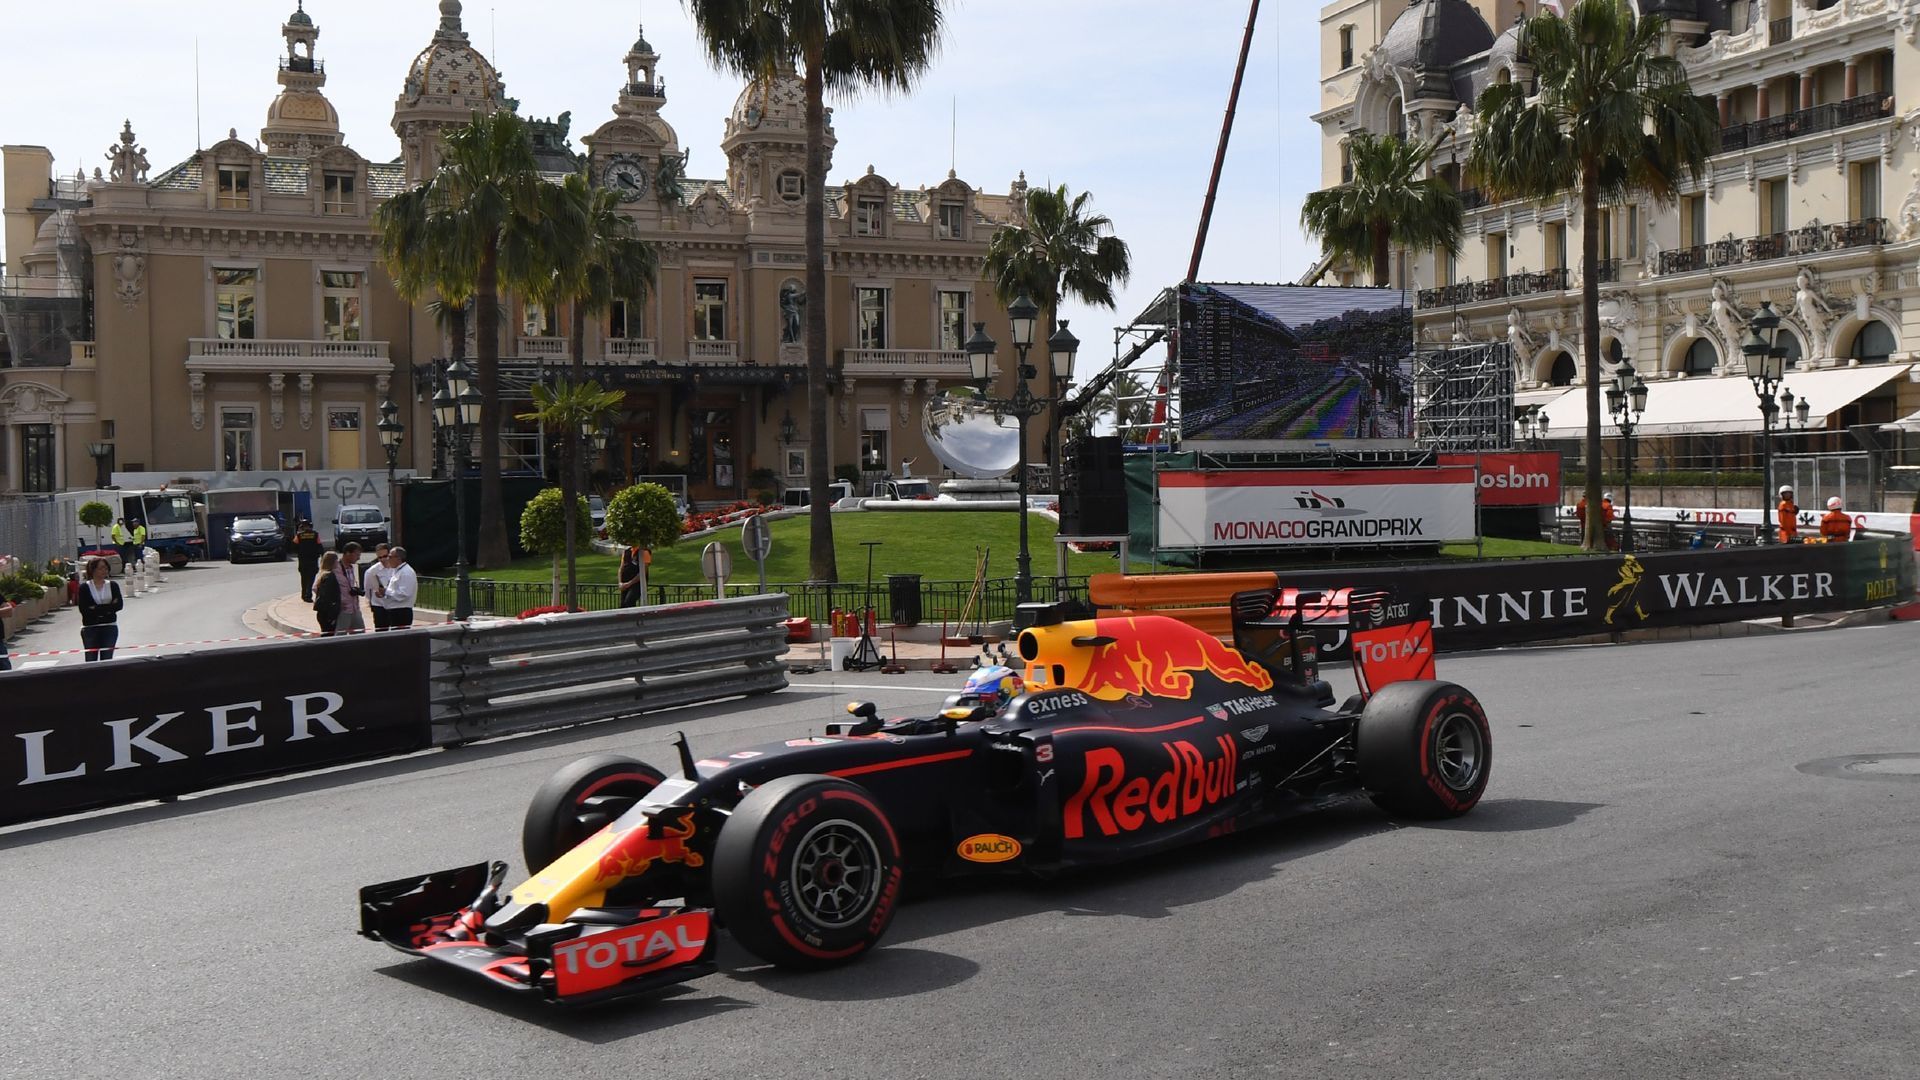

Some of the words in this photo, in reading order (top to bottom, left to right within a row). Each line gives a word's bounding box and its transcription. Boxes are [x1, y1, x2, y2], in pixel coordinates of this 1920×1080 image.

[260, 476, 381, 500] OMEGA
[1214, 517, 1423, 540] MONACOGRANDPRIX
[1658, 572, 1834, 608] WALKER
[1866, 577, 1897, 601] ROLEX
[1386, 602, 1410, 620] AT&T
[1354, 635, 1428, 664] TOTAL
[1028, 692, 1088, 714] exness
[1036, 744, 1054, 762] 3
[974, 841, 1013, 853] RAUCH
[554, 924, 706, 974] TOTAL
